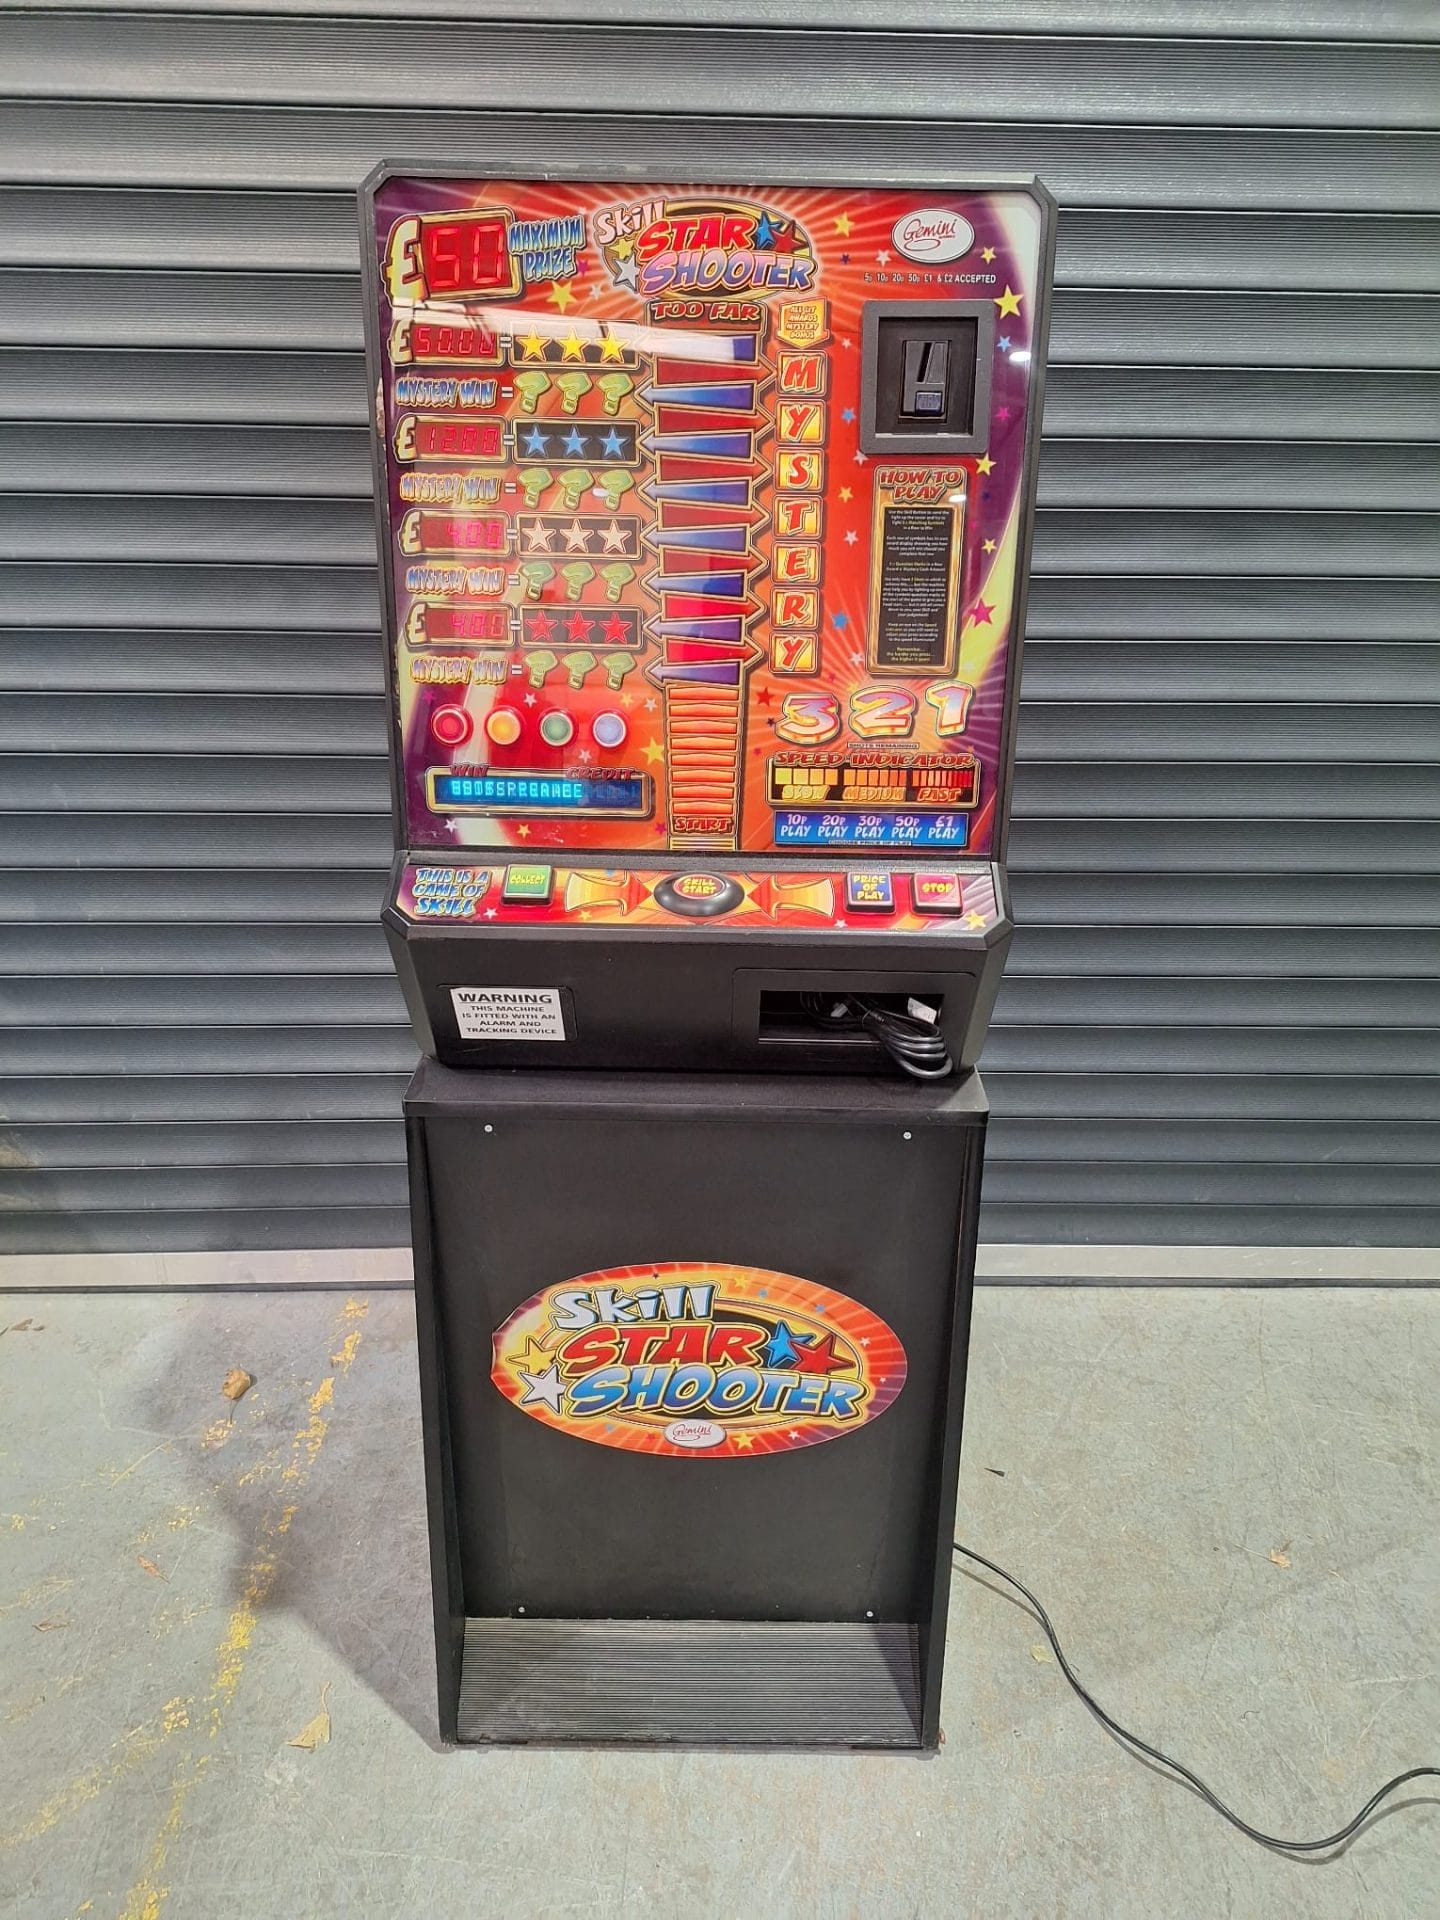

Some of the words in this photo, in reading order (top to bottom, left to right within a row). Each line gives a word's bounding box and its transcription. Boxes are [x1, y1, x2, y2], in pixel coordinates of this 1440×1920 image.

[599, 200, 665, 244] Skill
[509, 217, 584, 252] MAXIMUM
[637, 214, 757, 258] STAR
[903, 218, 957, 251] Gemini
[525, 250, 576, 279] PRIZE
[641, 250, 815, 295] SHOOTER
[944, 274, 953, 283] £2
[954, 274, 997, 283] ACCEPTED
[652, 303, 704, 319] TOO
[709, 303, 760, 321] FAR
[396, 379, 457, 406] MYSTERY
[460, 379, 497, 407] WIN
[880, 470, 928, 486] HOW
[934, 471, 962, 486] TO
[401, 475, 462, 501] MYSTERY
[463, 476, 499, 502] WIN
[894, 485, 945, 501] PLAY
[406, 567, 466, 594] MYSTERY
[468, 567, 504, 594] WIN
[775, 693, 840, 744] 3
[850, 686, 916, 738] 2
[926, 681, 973, 737] 1
[775, 752, 844, 767] SPEED
[851, 752, 975, 768] INDICATOR
[842, 786, 907, 801] MEDIUM
[917, 788, 961, 801] FAST
[675, 817, 731, 831] START
[780, 825, 811, 837] PLAY
[817, 826, 848, 838] PLAY
[854, 826, 886, 838] PLAY
[891, 827, 922, 838] PLAY
[928, 827, 960, 839] PLAY
[417, 868, 454, 883] THIS
[456, 869, 472, 884] IS
[475, 870, 490, 884] A
[510, 874, 546, 884] COLLECT
[683, 878, 716, 886] SKILL
[853, 875, 886, 884] PRICE
[412, 883, 461, 897] GAME
[462, 884, 487, 898] OF
[681, 885, 717, 894] START
[862, 883, 878, 891] OF
[921, 882, 954, 894] STOP
[856, 891, 885, 900] PLAY
[414, 897, 476, 915] SKILL
[458, 993, 552, 1004] WARNING
[496, 1005, 545, 1013] MACHINE
[553, 1284, 718, 1330] Skill
[562, 1323, 768, 1375] STAR
[567, 1364, 868, 1418] SHOOTER
